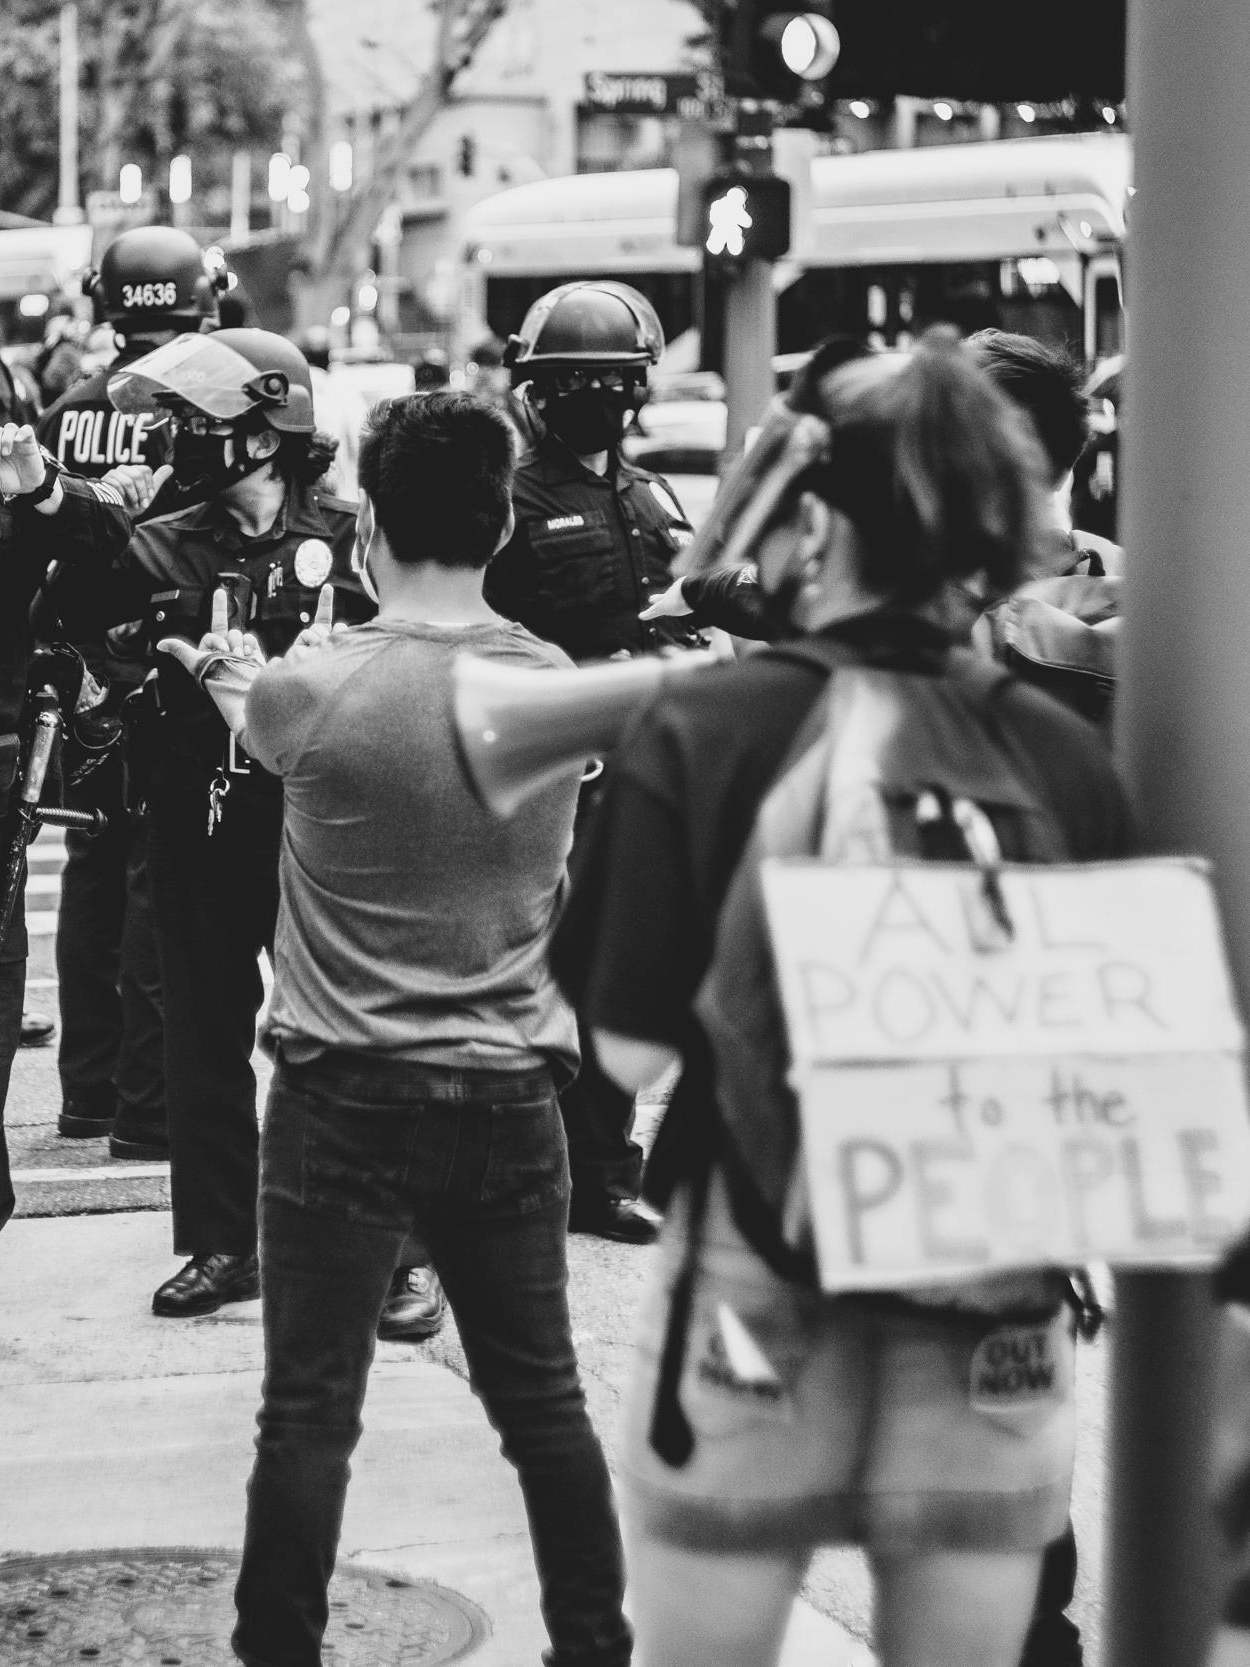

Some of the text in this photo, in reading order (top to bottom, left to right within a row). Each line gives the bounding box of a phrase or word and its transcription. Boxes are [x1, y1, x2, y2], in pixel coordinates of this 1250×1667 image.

[122, 282, 177, 307] 34636
[58, 410, 154, 464] POLICE
[856, 870, 1110, 966] ALL
[797, 959, 1172, 1048] POWER
[940, 1064, 1136, 1140] to the
[838, 1128, 1236, 1264] PEOPLE
[978, 1364, 1053, 1397] NOW
[986, 1333, 1048, 1367] OUT
